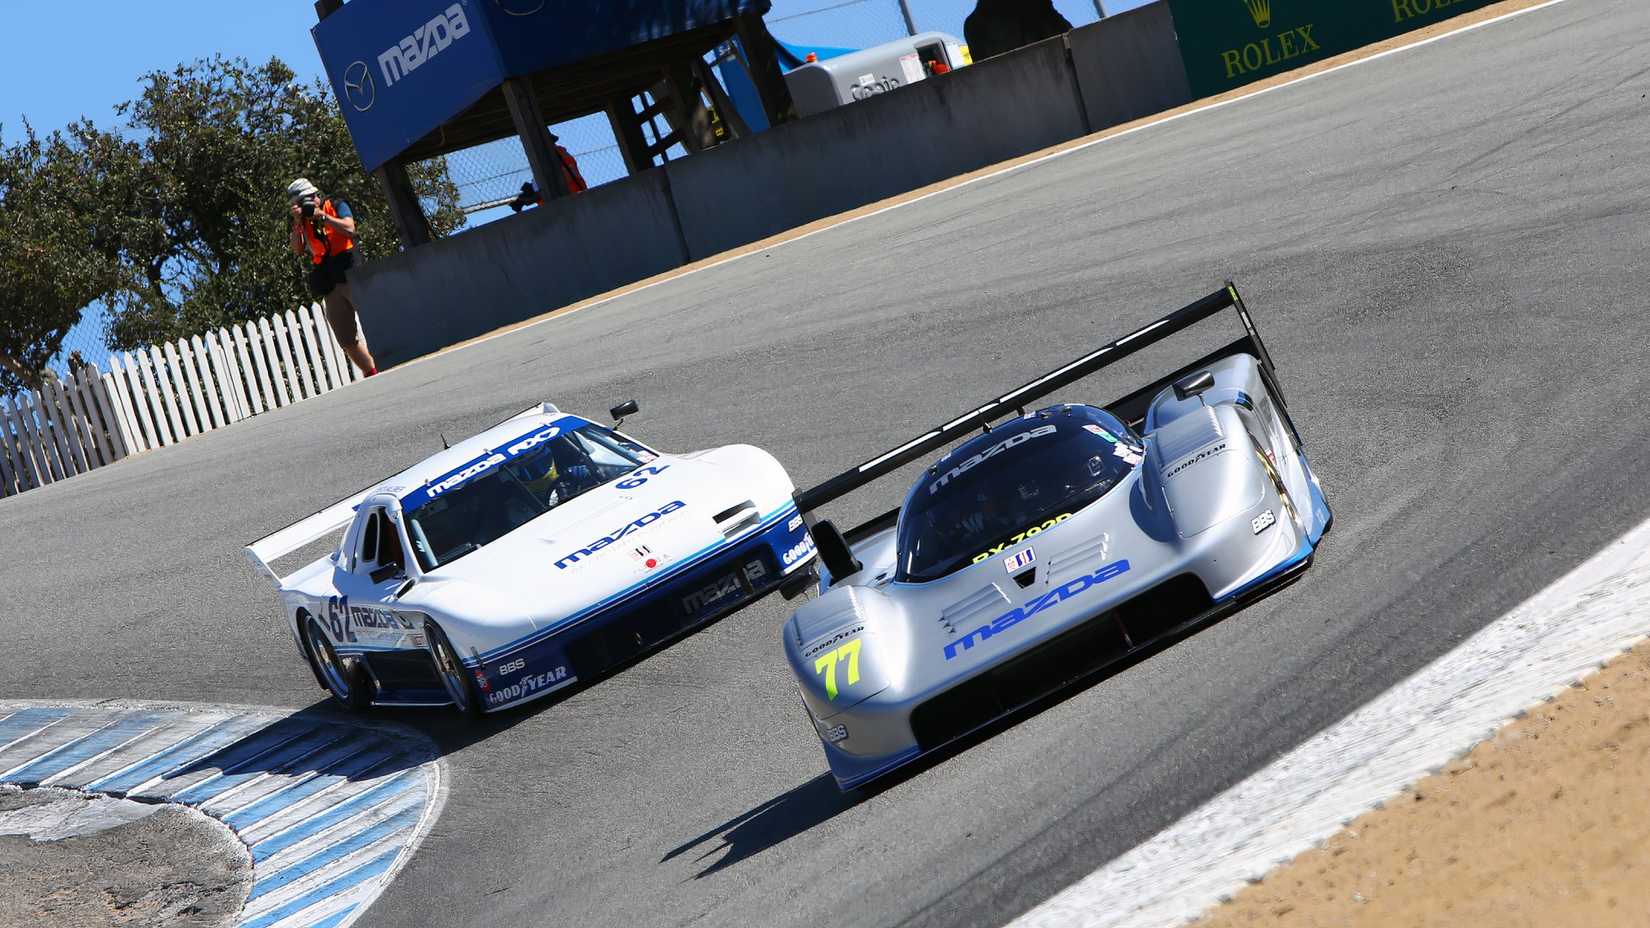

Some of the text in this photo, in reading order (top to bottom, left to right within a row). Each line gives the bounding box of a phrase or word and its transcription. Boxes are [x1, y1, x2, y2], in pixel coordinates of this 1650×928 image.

[377, 2, 471, 87] mazda
[1220, 24, 1320, 79] ROLEX
[615, 464, 671, 489] 62
[928, 424, 1057, 494] mazda
[553, 500, 686, 570] mazda
[1251, 509, 1276, 535] BBS
[328, 595, 358, 642] 62
[943, 559, 1131, 660] mazda
[499, 658, 525, 676] BBS
[815, 638, 861, 701] 77
